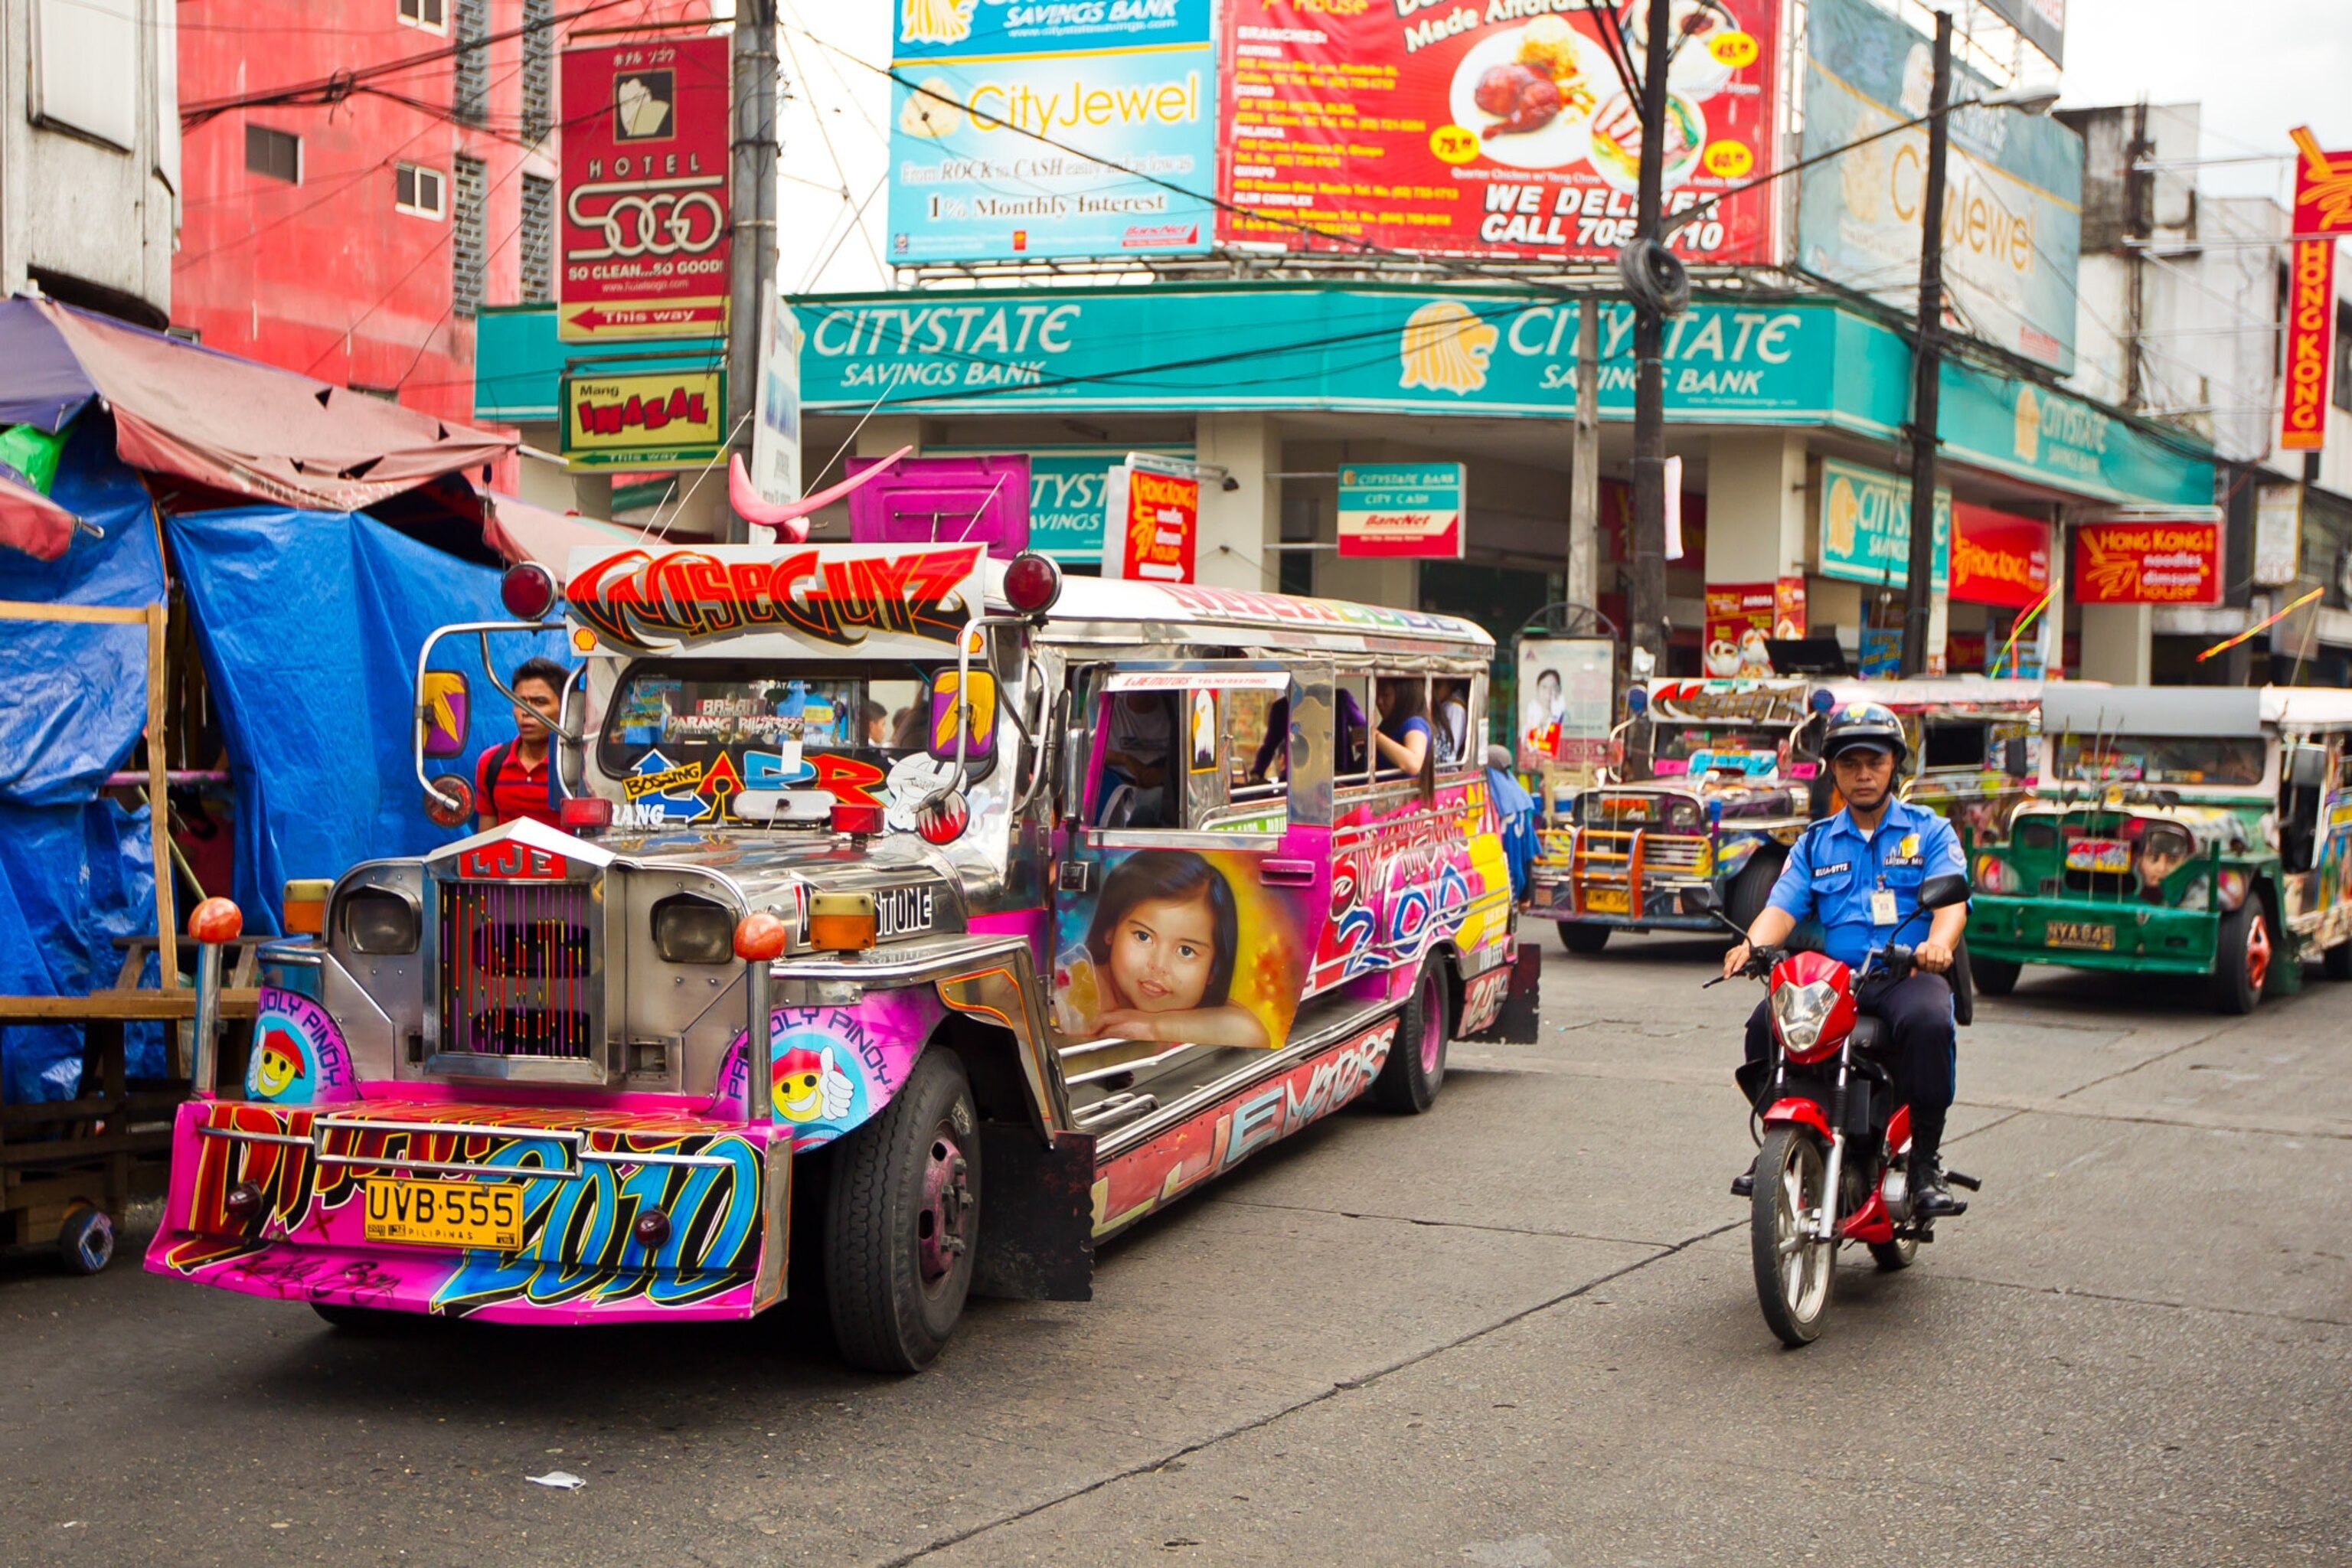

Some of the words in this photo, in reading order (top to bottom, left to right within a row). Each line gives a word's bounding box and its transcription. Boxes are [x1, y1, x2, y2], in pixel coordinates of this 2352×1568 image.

[1004, 3, 1106, 28] SAVINGS
[1109, 0, 1178, 21] BANK
[1404, 7, 1478, 53] Made
[590, 153, 700, 179] HOTEL
[942, 162, 994, 180] ROCK
[1014, 159, 1064, 177] CASH
[975, 194, 1067, 220] Monthly
[1078, 193, 1165, 213] Interest
[1485, 184, 1544, 213] WE
[568, 175, 724, 260] SOGO
[1481, 214, 1566, 245] CALL
[569, 263, 589, 281] SO
[677, 259, 724, 276] GOOD!
[2299, 241, 2327, 330] HONG
[602, 309, 647, 325] This
[654, 309, 695, 324] way
[813, 304, 1081, 356] CITYSTATE
[1508, 306, 1801, 364] CITYTATE
[841, 362, 959, 387] SAVINGS
[964, 360, 1047, 385] BANK
[1676, 369, 1764, 396] BANK
[2291, 333, 2324, 428] KONG
[580, 384, 619, 398] Mang
[1365, 494, 1391, 505] CITY
[1396, 493, 1429, 505] CASH
[1365, 514, 1430, 527] BancNet
[2101, 530, 2151, 551] HONG
[626, 766, 700, 795] BOSSING
[302, 1011, 341, 1086] PINOY
[828, 1009, 893, 1087] PINOY
[409, 1228, 473, 1240] PILIPINAS
